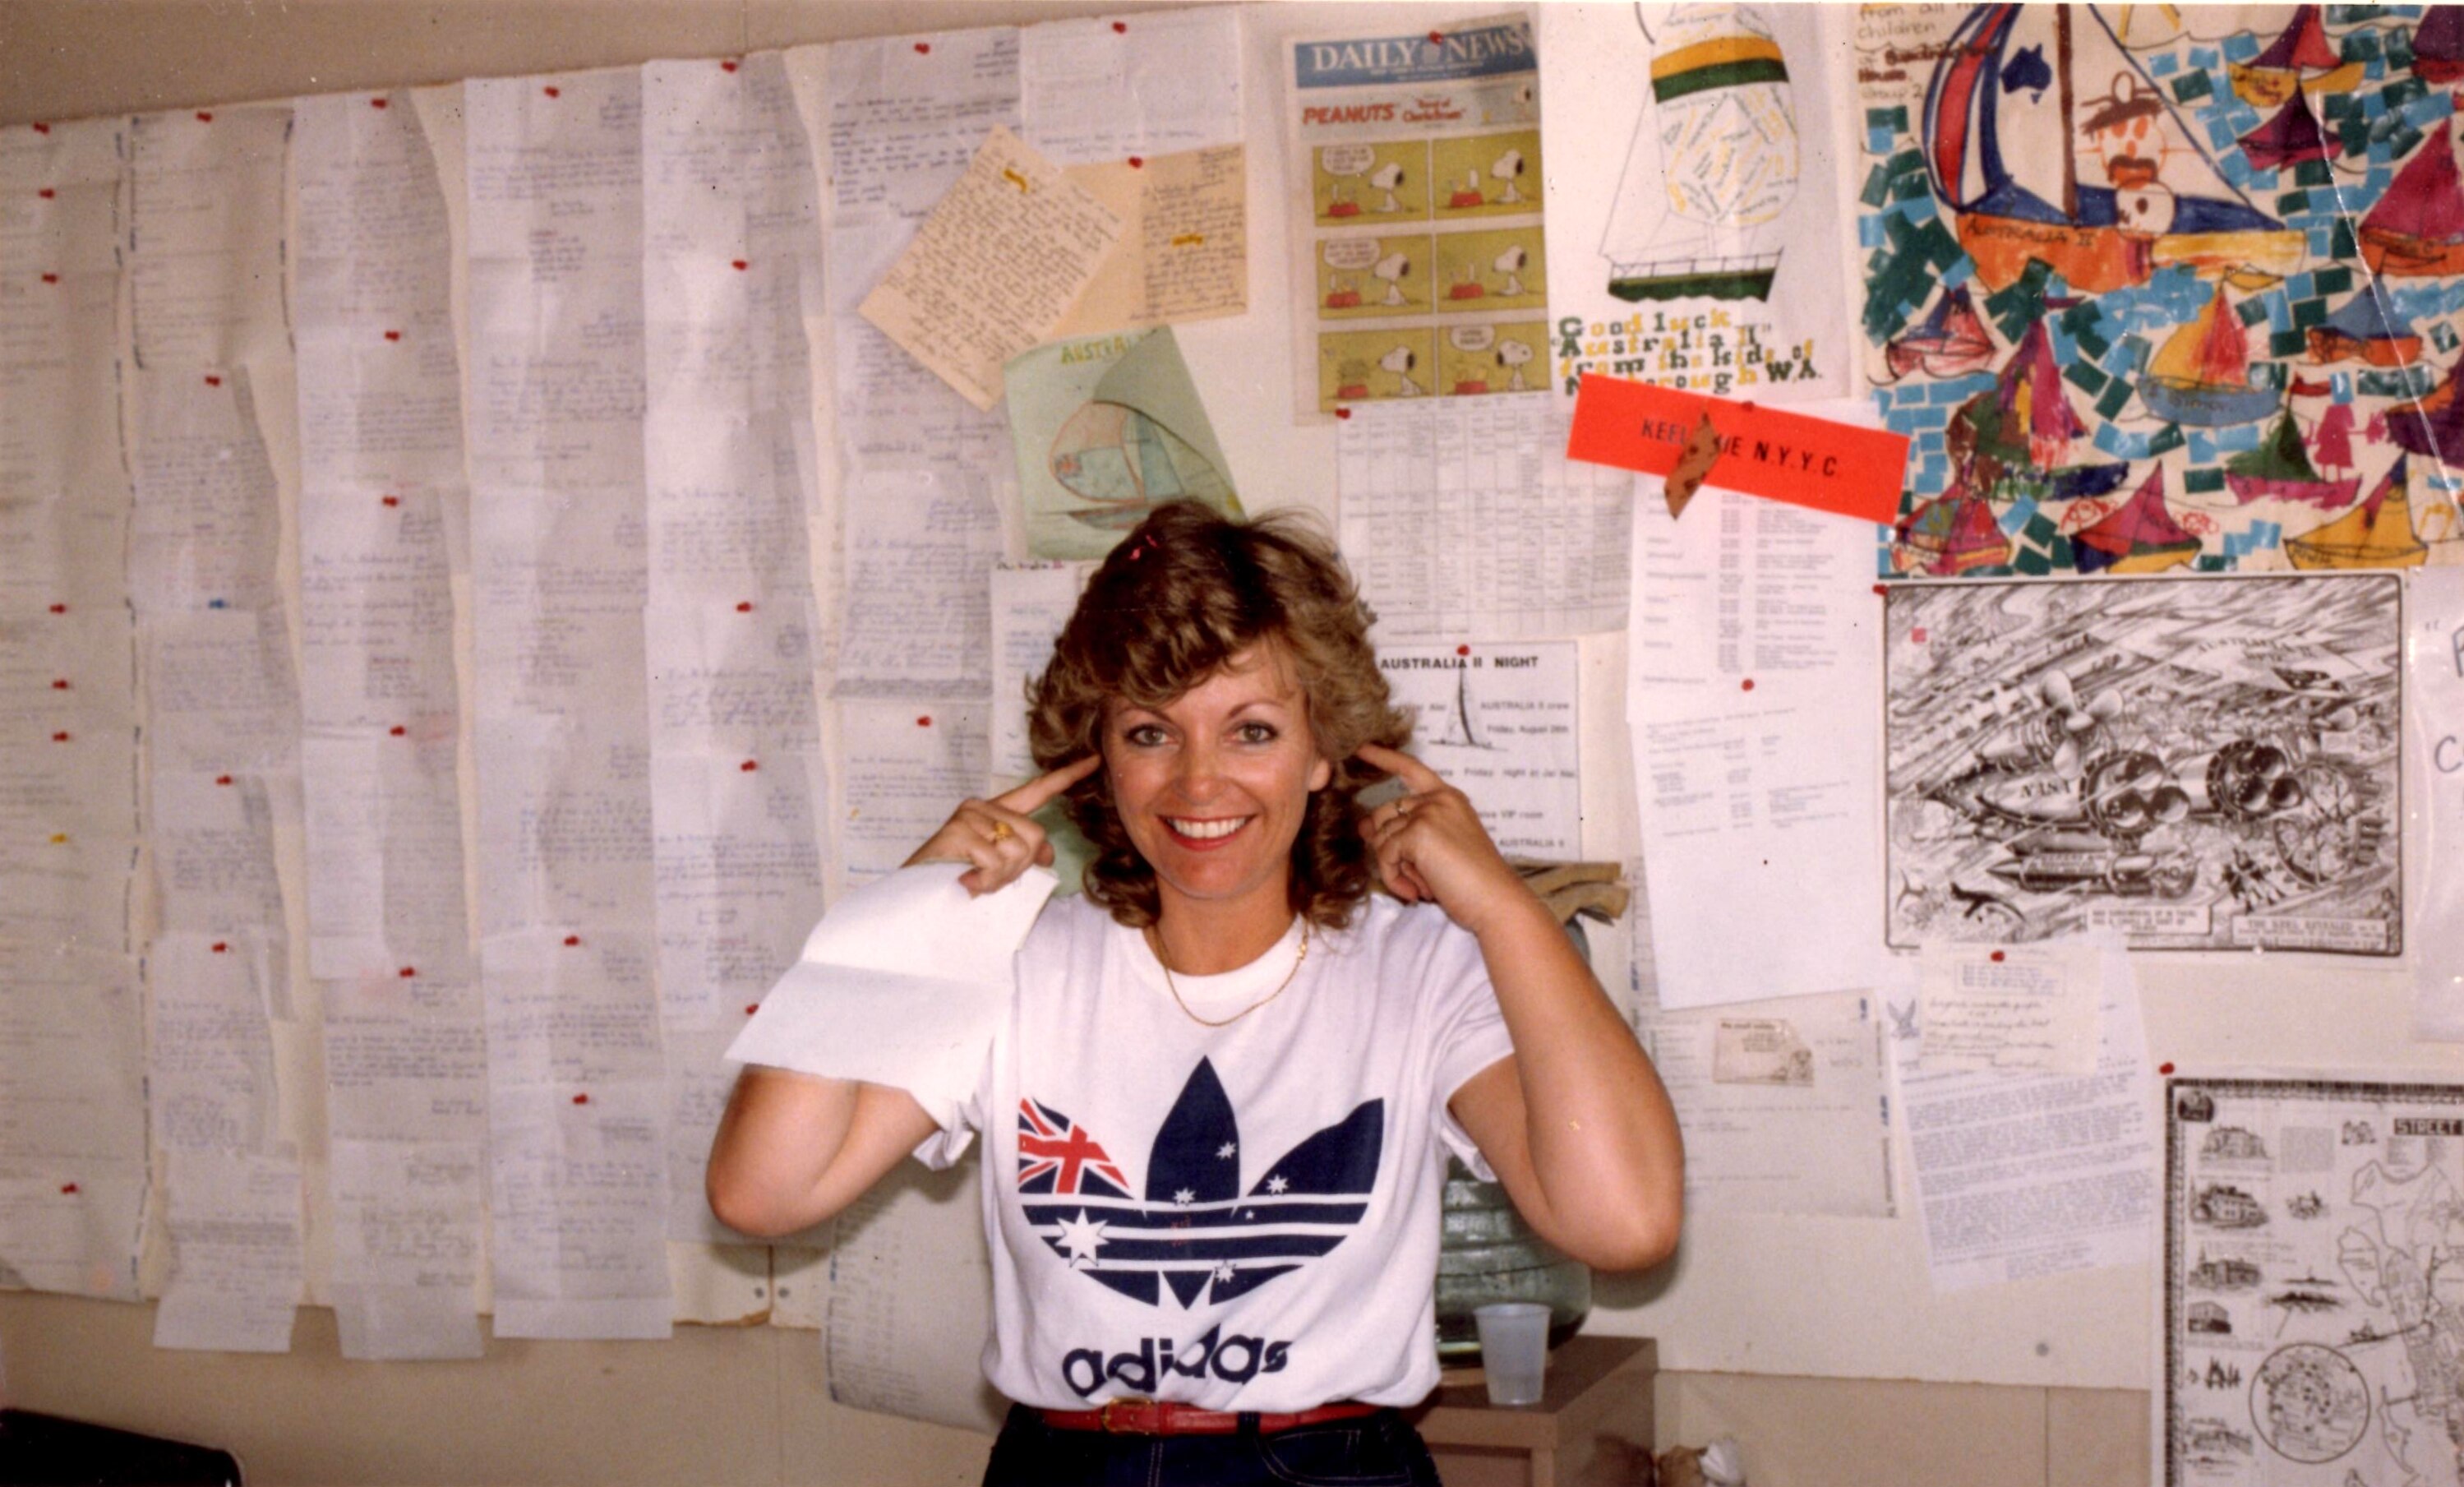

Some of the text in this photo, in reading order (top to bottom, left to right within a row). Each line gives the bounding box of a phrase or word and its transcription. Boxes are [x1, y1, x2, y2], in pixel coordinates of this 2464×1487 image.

[1312, 25, 1525, 72] DAILY NEWS
[1912, 84, 1922, 99] 2
[1303, 103, 1395, 125] PEANUTS
[1558, 307, 1730, 338] Good luck
[1712, 343, 1774, 367] kids
[1793, 338, 1814, 361] of
[1641, 419, 1687, 446] KEEL
[1381, 657, 1539, 669] AUSTRALIA II NIGHT
[1480, 702, 1534, 710] AUSTRALIA
[1501, 810, 1516, 819] VIP
[2397, 1120, 2455, 1134] STREET
[1062, 1323, 1294, 1397] adidas
